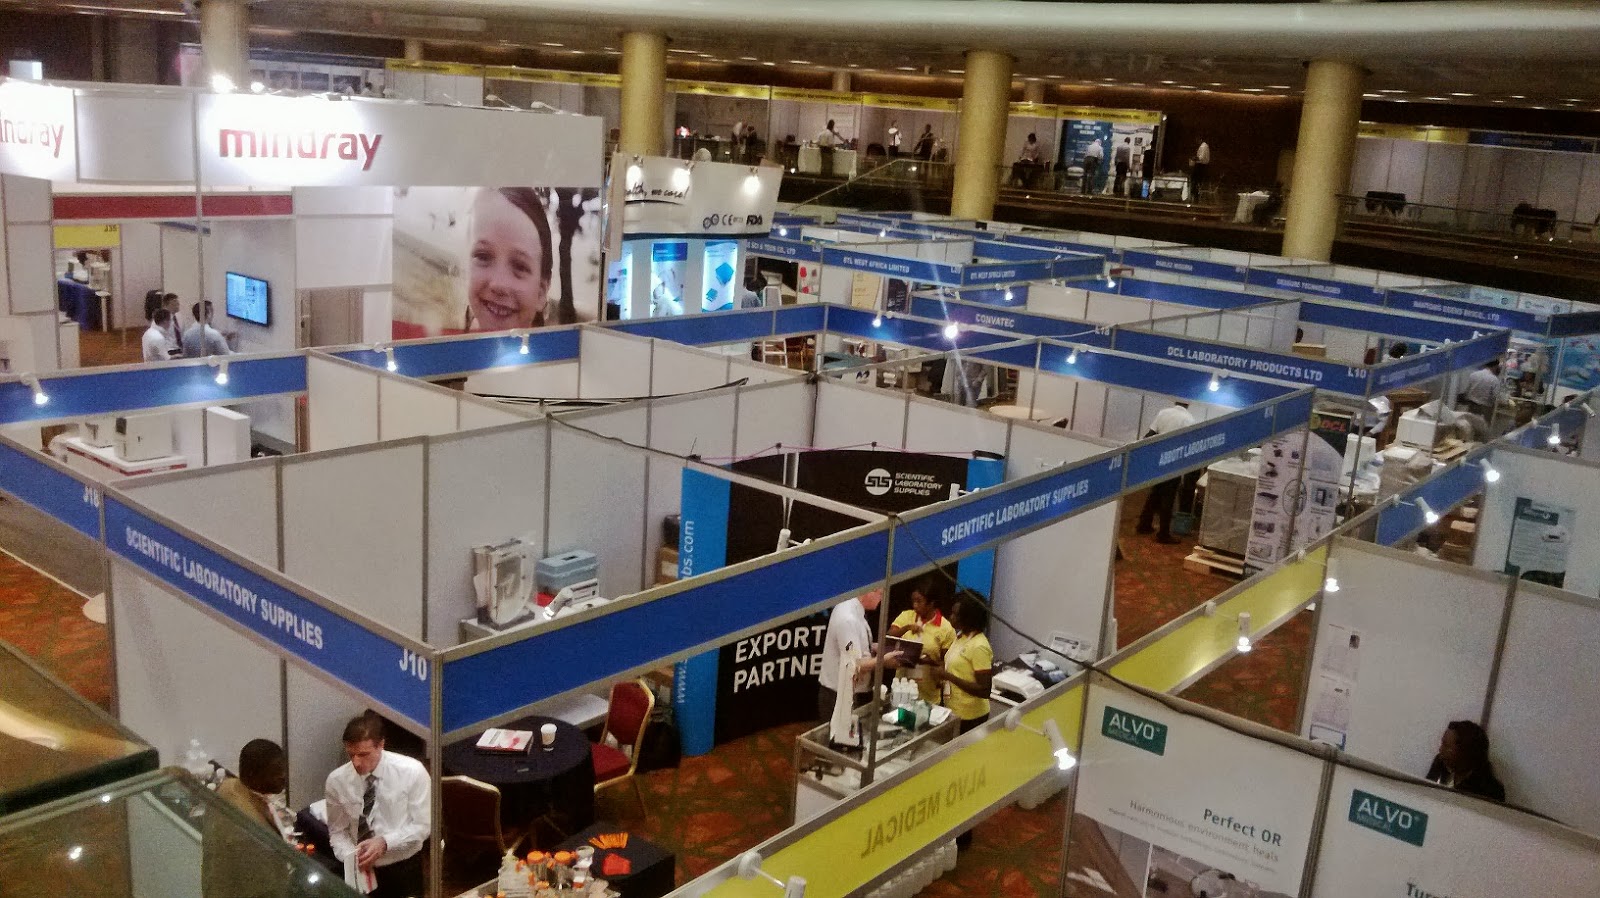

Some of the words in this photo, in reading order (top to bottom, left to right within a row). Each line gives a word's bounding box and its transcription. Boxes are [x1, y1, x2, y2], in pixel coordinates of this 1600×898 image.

[975, 313, 1015, 329] CONVATEC
[1187, 348, 1248, 368] LABORATORY
[1250, 359, 1302, 378] PRODUCTS
[1303, 368, 1323, 382] LTD
[894, 486, 930, 497] SUPPLIES
[895, 472, 935, 482] SCIENTIFIC
[895, 479, 943, 491] LABORATORY
[941, 511, 995, 546] SCIENTIFIC
[995, 491, 1052, 527] LABORATORY
[1052, 479, 1090, 506] SUPPLIES
[125, 525, 182, 574] SCIENTIFIC
[182, 555, 258, 615] LABORATORY
[260, 598, 324, 650] SUPPLIES
[735, 625, 827, 664] EXPORT
[399, 648, 427, 681] J10
[1108, 713, 1155, 740] ALVO
[1129, 799, 1185, 830] Harmonious
[1204, 807, 1256, 838] Perfect
[1261, 829, 1282, 847] OR
[1357, 797, 1413, 829] ALVO
